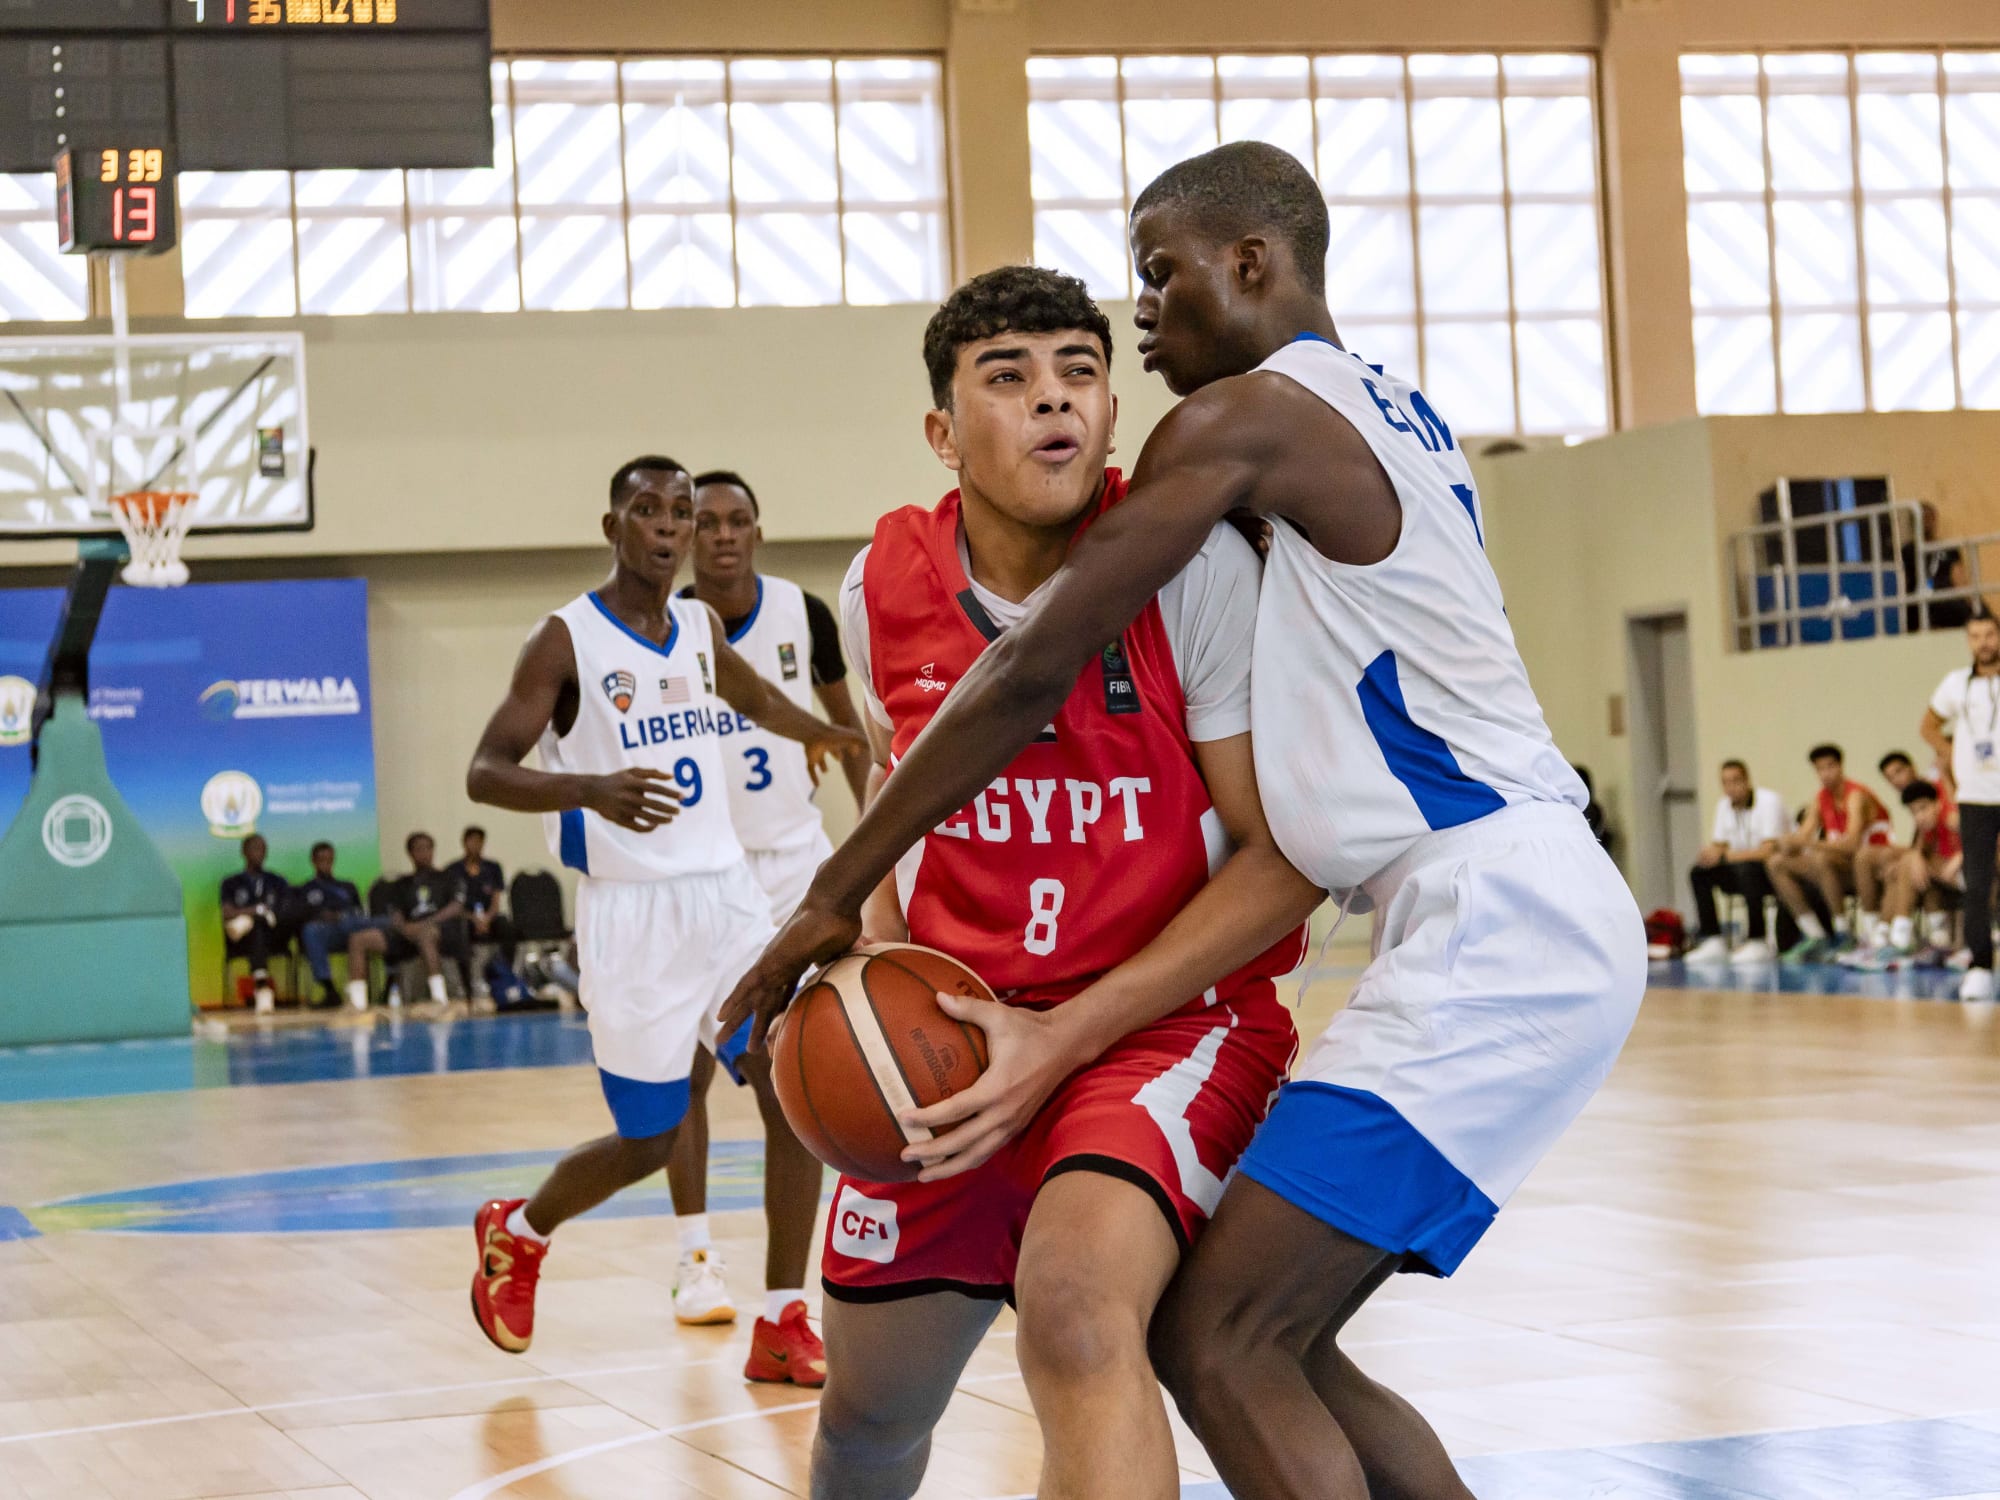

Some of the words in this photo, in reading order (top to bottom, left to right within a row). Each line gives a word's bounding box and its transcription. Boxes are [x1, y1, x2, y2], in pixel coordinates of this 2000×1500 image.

[101, 148, 119, 182] 3
[127, 148, 163, 182] 39
[113, 186, 156, 241] 13
[619, 705, 716, 750] LIBERIA
[673, 756, 703, 808] 9
[743, 746, 773, 792] 3
[1023, 877, 1066, 957] 8
[841, 1209, 889, 1241] CFI
